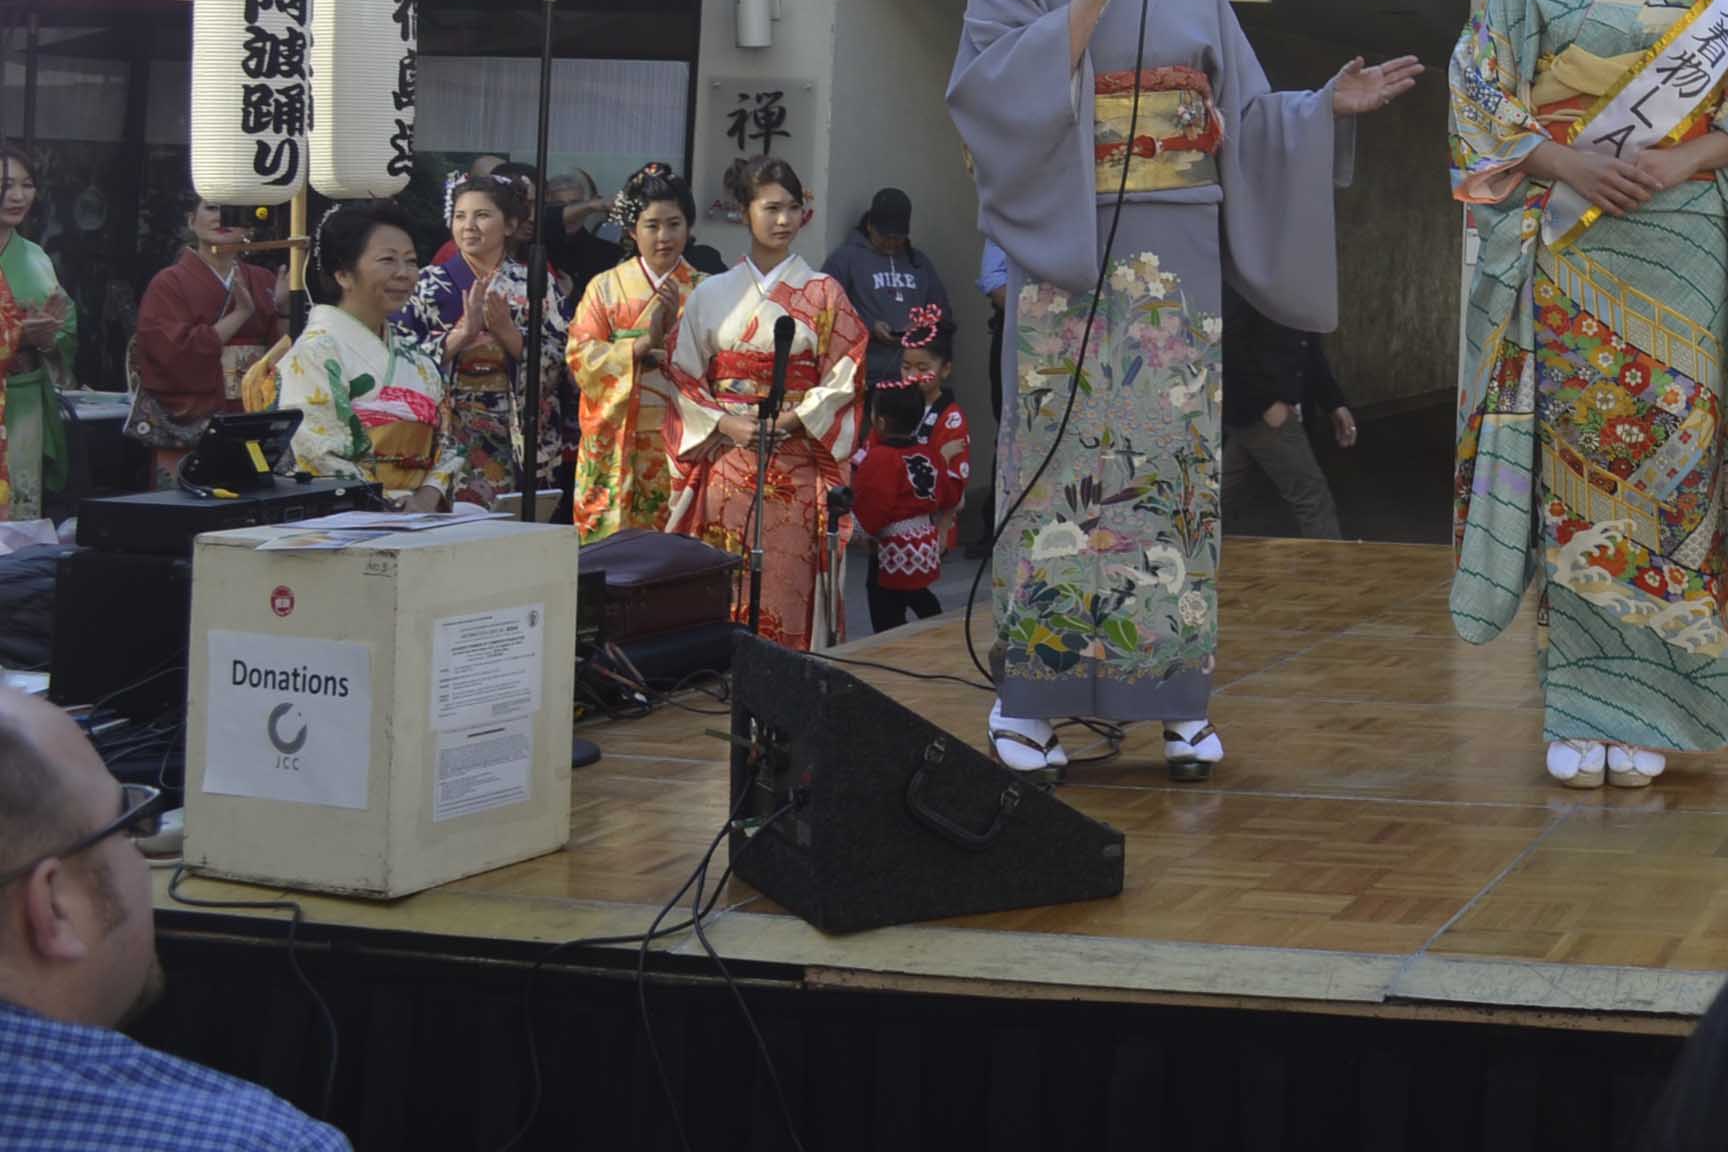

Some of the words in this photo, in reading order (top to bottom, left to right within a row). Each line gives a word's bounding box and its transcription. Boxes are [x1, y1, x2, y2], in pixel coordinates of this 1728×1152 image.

[872, 271, 917, 289] NIKE
[231, 659, 350, 697] Donations
[275, 755, 301, 772] JCC
